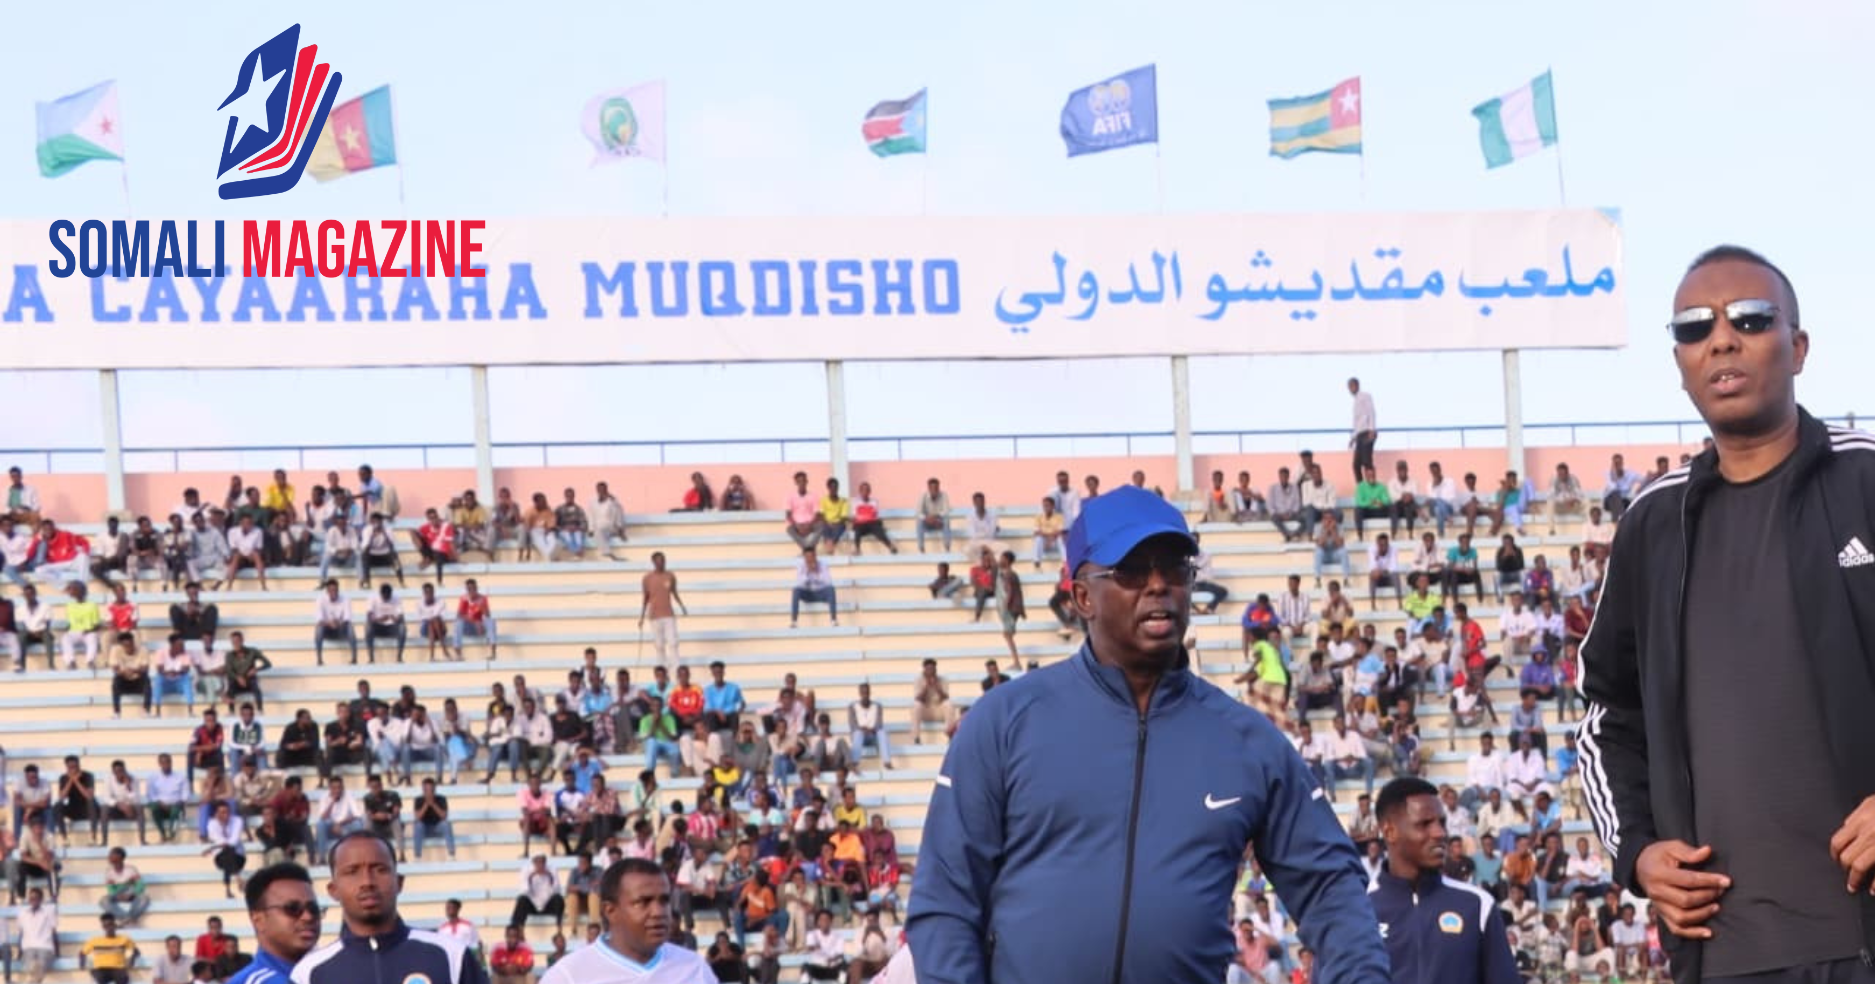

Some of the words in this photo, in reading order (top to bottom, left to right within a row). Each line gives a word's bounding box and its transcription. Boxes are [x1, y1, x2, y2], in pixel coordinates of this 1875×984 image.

[581, 259, 960, 318] MUQDISHO
[994, 250, 1183, 333] الدولي
[1196, 247, 1446, 320] مقديشو
[1458, 243, 1618, 316] ملعب
[1839, 555, 1875, 568] adidas
